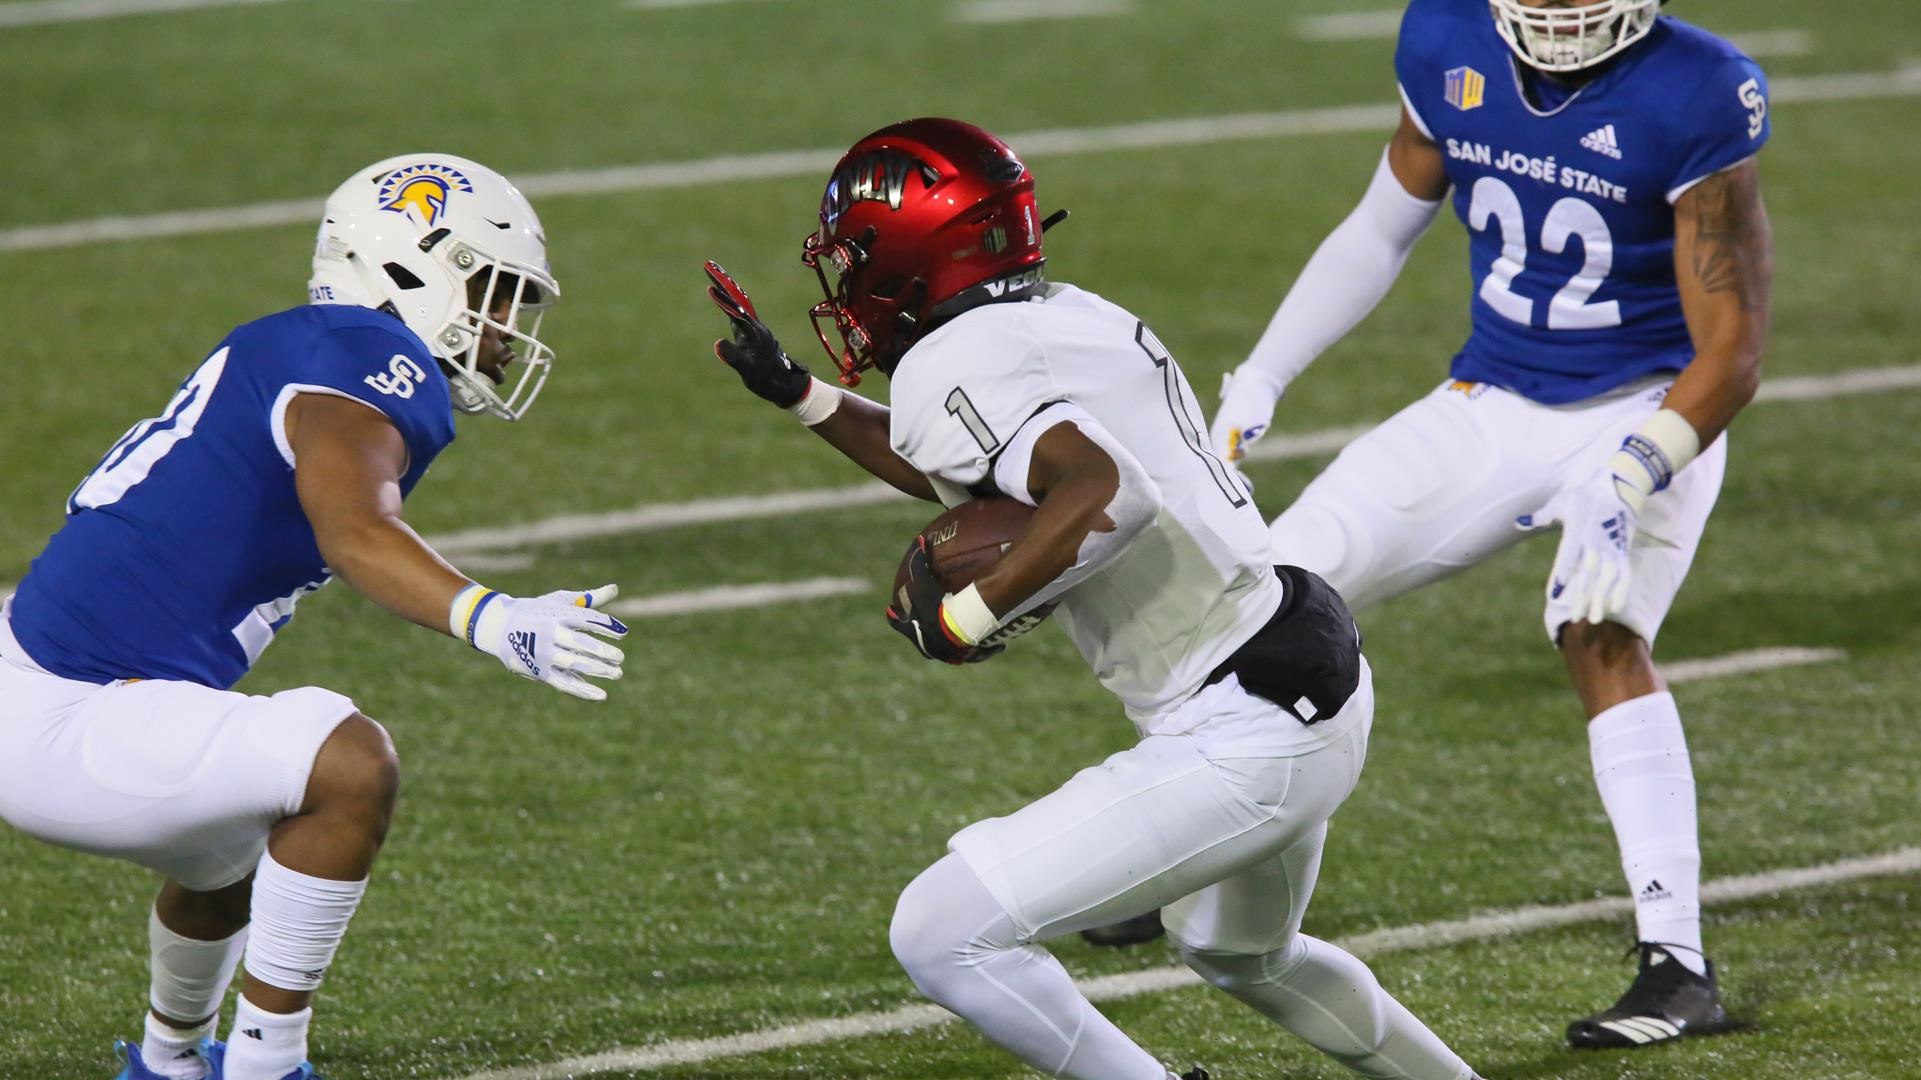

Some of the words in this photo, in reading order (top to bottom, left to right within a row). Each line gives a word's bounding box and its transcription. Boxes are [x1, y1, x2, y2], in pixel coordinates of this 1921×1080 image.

[1446, 138, 1491, 165] SAN
[1495, 150, 1557, 183] JOSÉ
[1560, 167, 1628, 203] STATE
[1024, 205, 1035, 246] 1
[1469, 176, 1622, 330] 22
[943, 385, 1000, 454] 1
[1135, 321, 1247, 508] 1
[508, 632, 540, 676] adidas
